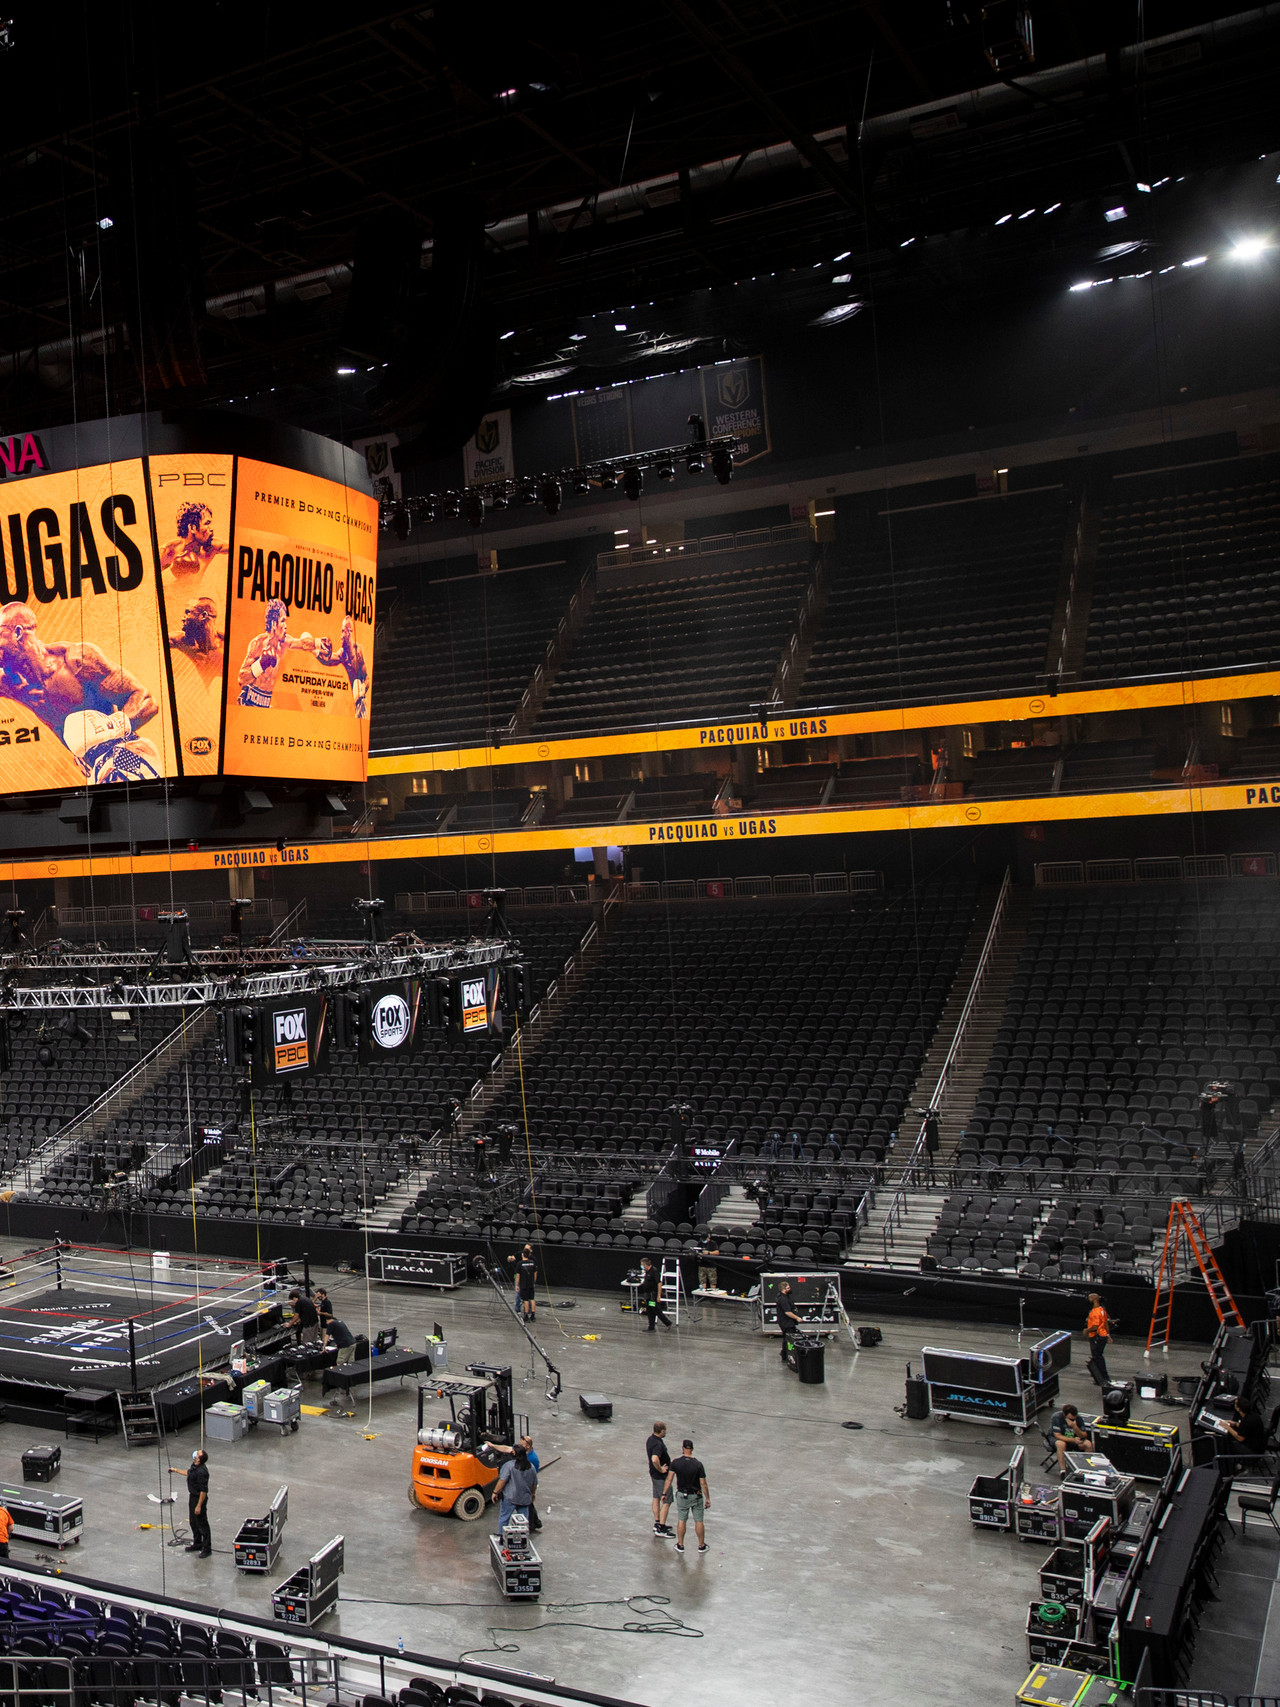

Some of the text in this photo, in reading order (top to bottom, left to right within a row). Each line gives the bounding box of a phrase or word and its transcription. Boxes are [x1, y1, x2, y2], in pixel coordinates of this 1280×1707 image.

[715, 409, 758, 425] WESTERN
[712, 417, 762, 435] CONFERENCE
[158, 472, 226, 487] PBC
[473, 465, 505, 477] DIVISION
[254, 491, 372, 534] PREMIER BOXING CHAMPIONS
[237, 545, 374, 625] PACQUIAO VS UGAS
[282, 673, 327, 688] SATURDAY
[327, 680, 341, 690] AUG
[342, 682, 349, 691] 21
[15, 726, 41, 744] 21
[700, 725, 768, 745] PACQUIAO
[789, 719, 828, 736] UGAS
[191, 739, 210, 749] FOX
[243, 734, 363, 753] PREMIER BOXING CHAMPIONS
[649, 822, 718, 843] PACQUIAO
[739, 819, 777, 835] UGAS
[214, 851, 266, 867] PACQUIAO
[281, 848, 309, 862] UGAS
[1249, 860, 1258, 872] 4
[712, 884, 718, 894] 5
[470, 896, 477, 905] 6
[144, 909, 149, 918] 7
[463, 982, 485, 1007] FOX
[380, 1004, 402, 1028] FOX
[465, 1009, 486, 1025] PBC
[276, 1013, 306, 1043] FOX
[380, 1026, 403, 1039] SPORTS
[277, 1046, 307, 1066] PBC
[385, 1264, 434, 1274] JITACAM
[947, 1393, 1007, 1409] JITACAM
[420, 1456, 449, 1467] DOOSAN
